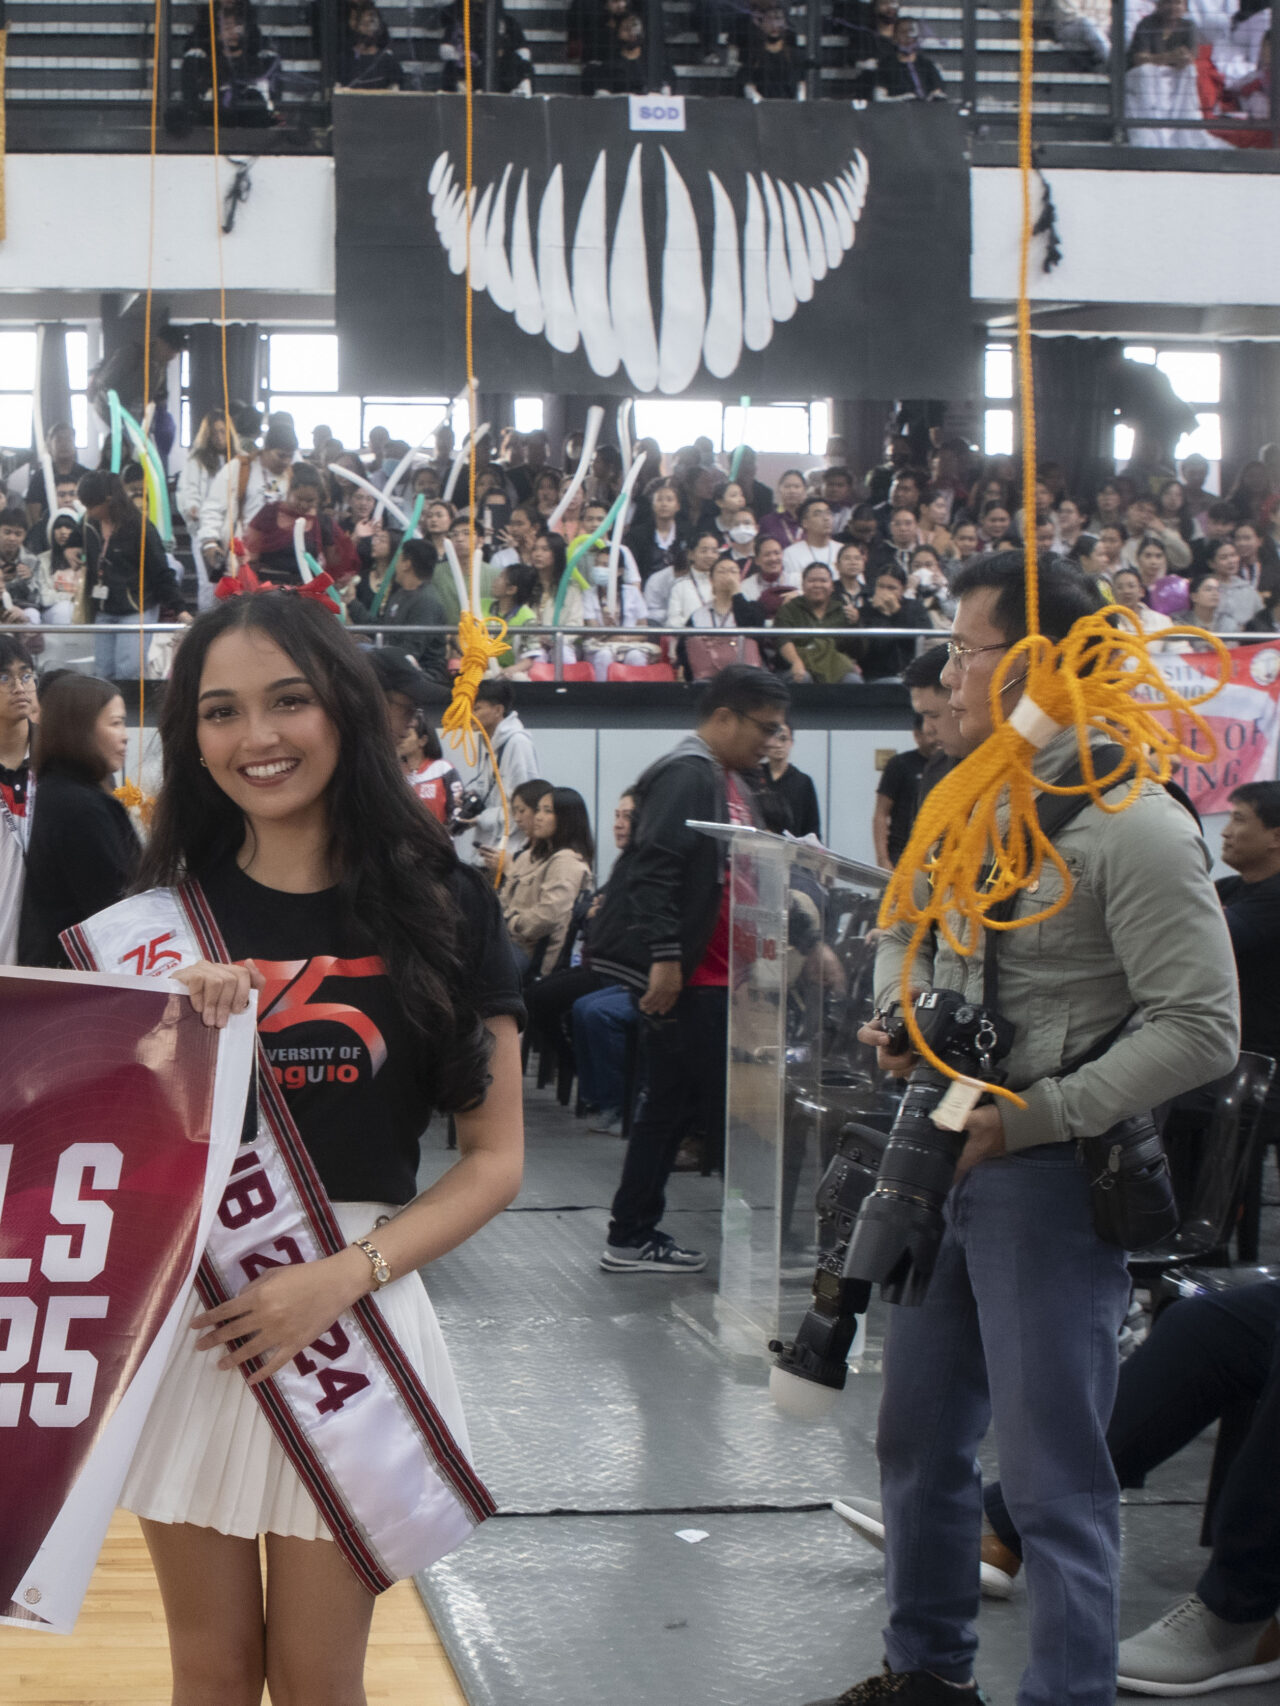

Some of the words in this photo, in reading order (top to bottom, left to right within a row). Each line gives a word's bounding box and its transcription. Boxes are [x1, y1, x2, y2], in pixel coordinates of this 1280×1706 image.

[639, 106, 680, 120] SOD
[117, 929, 183, 976] 75
[231, 955, 389, 1079] 75
[270, 1047, 334, 1062] VERSITY
[339, 1046, 362, 1060] OF
[273, 1064, 360, 1090] guio
[239, 1236, 371, 1415] 224
